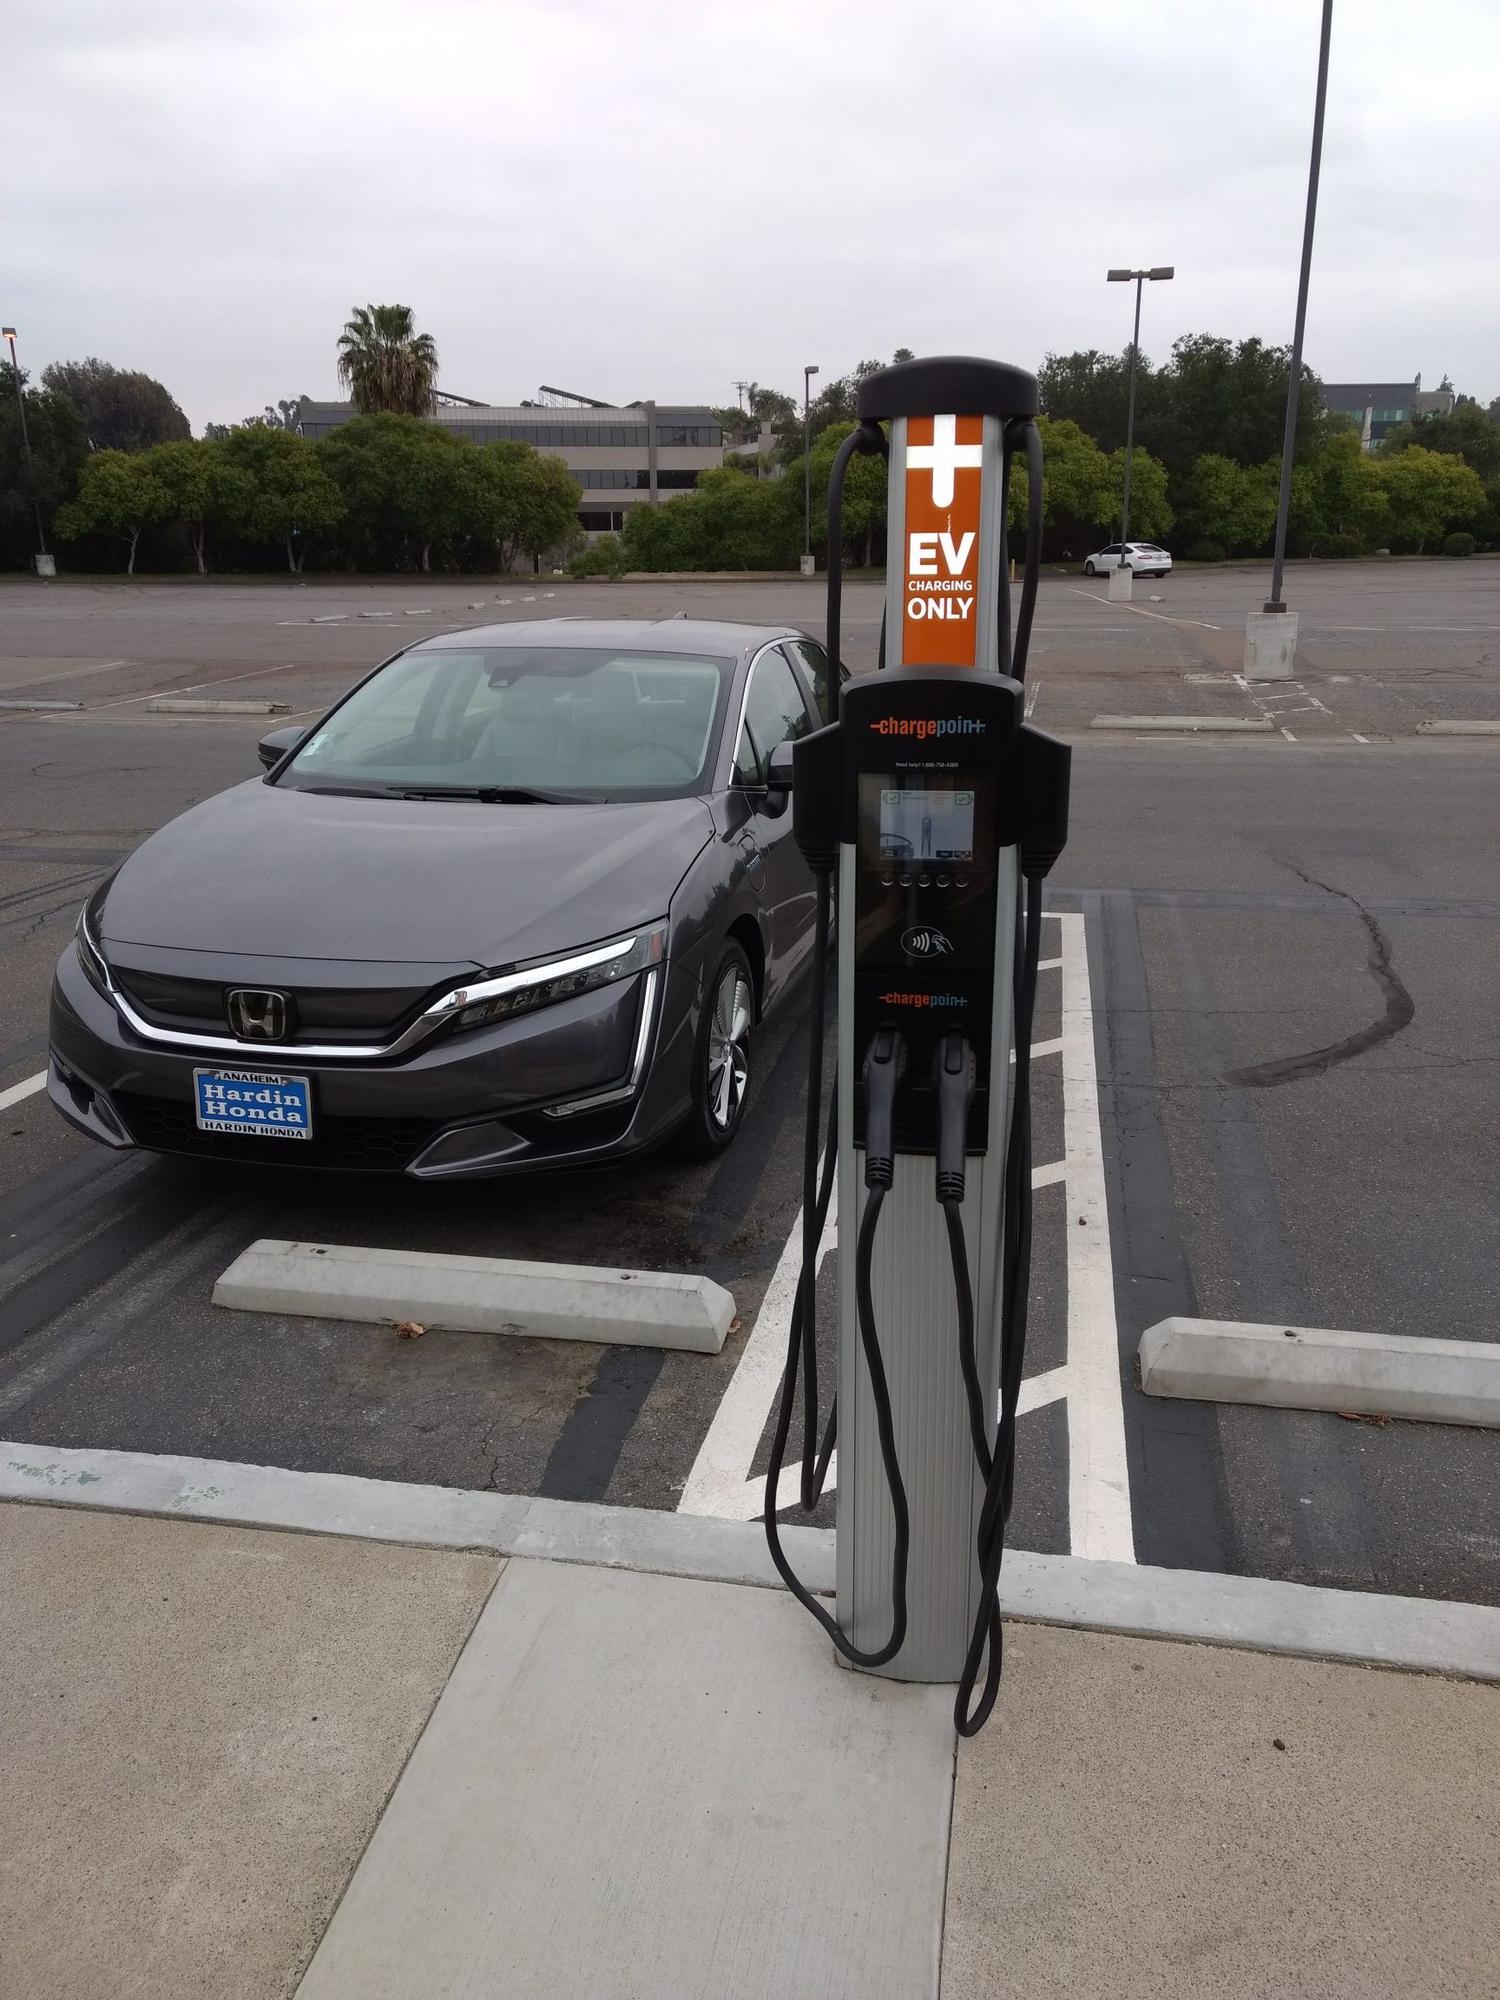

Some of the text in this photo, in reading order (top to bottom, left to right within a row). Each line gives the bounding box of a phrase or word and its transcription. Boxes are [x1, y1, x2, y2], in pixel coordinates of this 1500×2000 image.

[909, 532, 976, 575] EV
[908, 580, 973, 591] CHARGING
[907, 597, 974, 620] ONLY
[223, 1072, 279, 1084] ANAHEIM
[203, 1084, 302, 1106] Hardin
[204, 1100, 303, 1123] Honda
[205, 1121, 304, 1138] HARDIN HONDA
